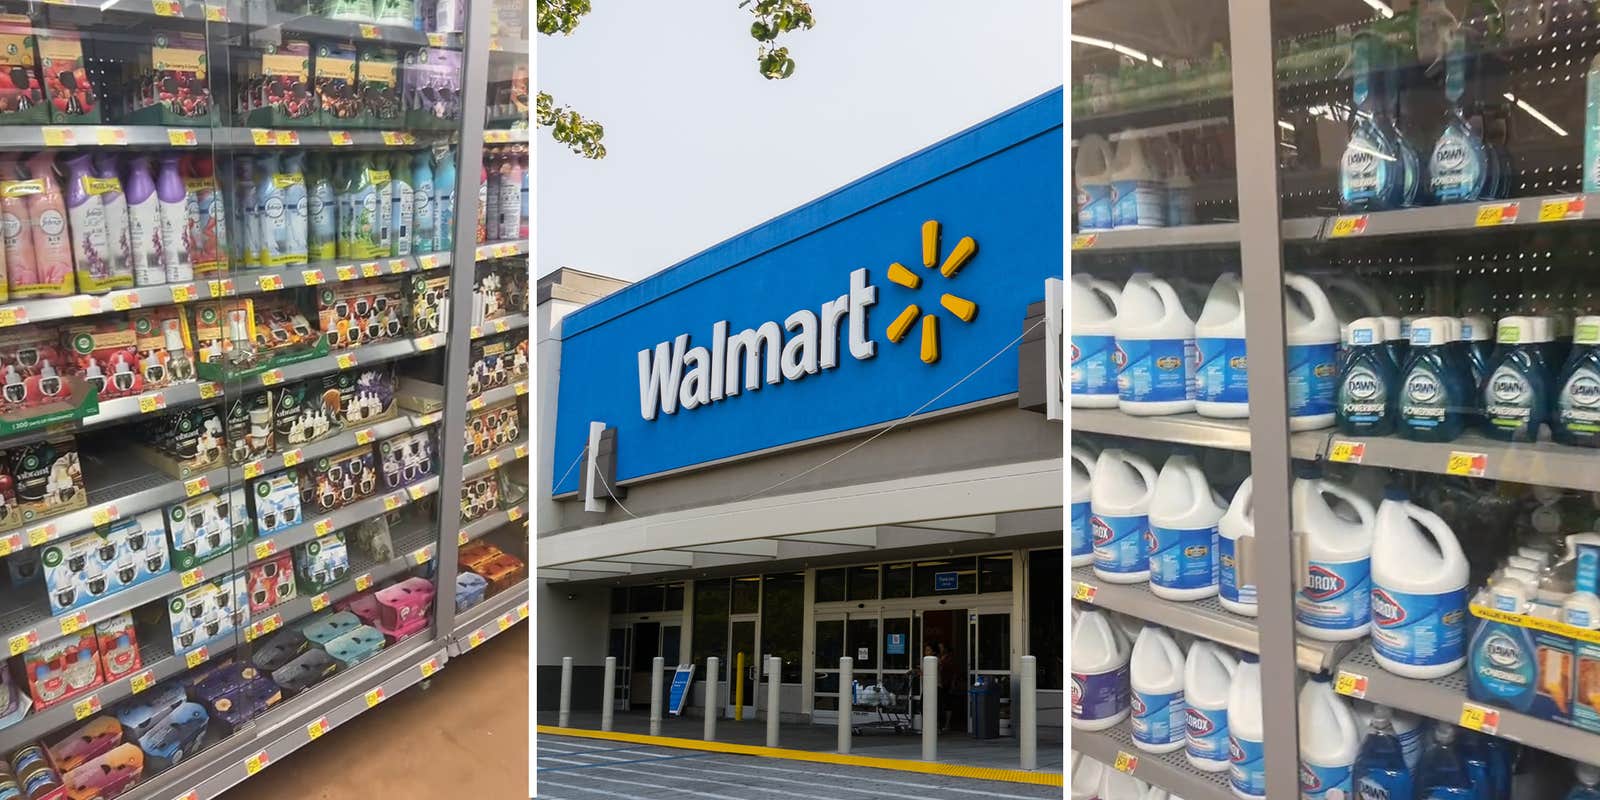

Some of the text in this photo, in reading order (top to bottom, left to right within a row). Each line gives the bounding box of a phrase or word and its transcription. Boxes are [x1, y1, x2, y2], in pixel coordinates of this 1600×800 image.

[638, 267, 878, 421] Walmart
[1349, 381, 1377, 392] DAWN
[1408, 383, 1437, 394] DAWN
[1493, 381, 1522, 393] DAWN
[175, 429, 200, 441] vibrant
[16, 466, 50, 481] vibrant
